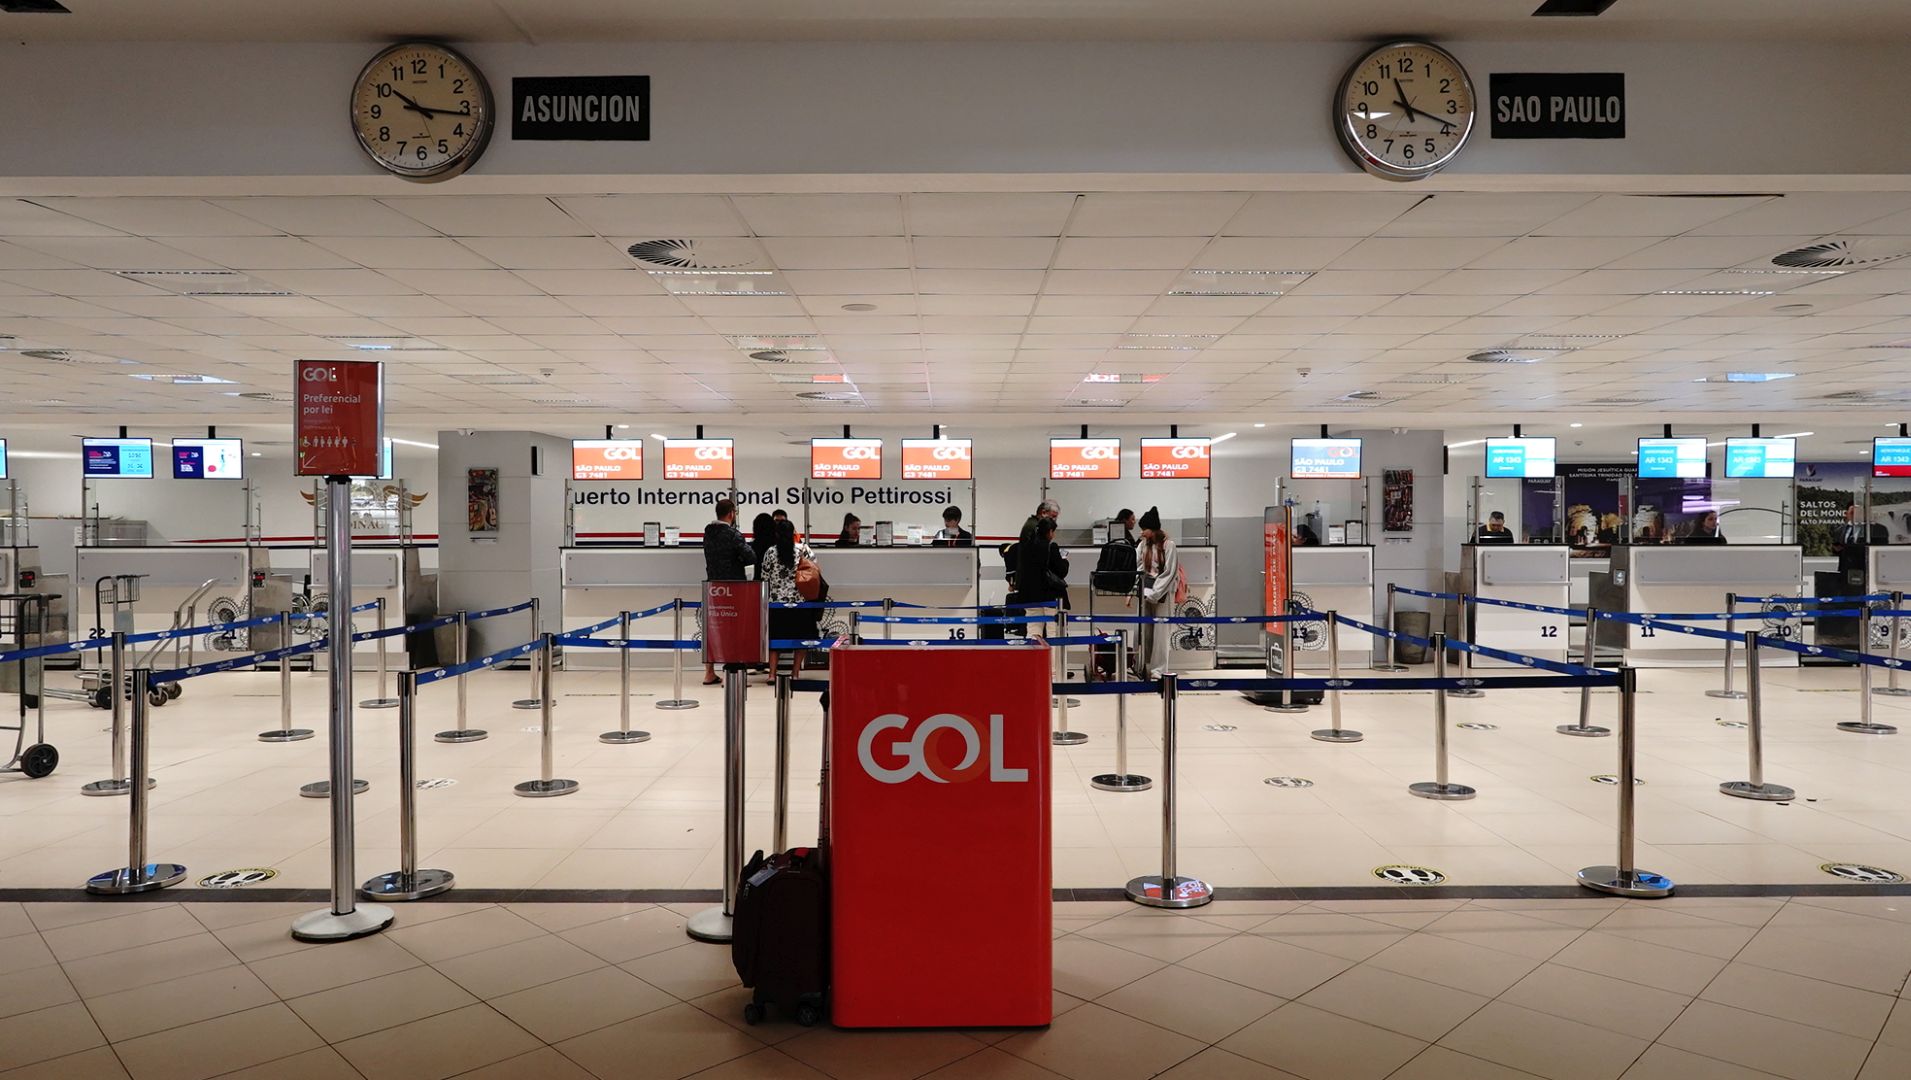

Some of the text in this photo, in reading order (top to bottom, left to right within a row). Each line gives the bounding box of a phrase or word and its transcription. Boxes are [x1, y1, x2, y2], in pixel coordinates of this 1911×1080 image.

[413, 59, 427, 74] 12
[438, 64, 444, 78] 1
[1379, 65, 1390, 79] 11
[1400, 59, 1413, 73] 12
[1425, 64, 1431, 78] 1
[392, 66, 404, 81] 11
[376, 83, 392, 98] 10
[453, 79, 464, 94] 2
[1362, 82, 1378, 96] 10
[1439, 79, 1450, 93] 2
[370, 104, 381, 119] 9
[460, 100, 470, 114] 3
[521, 96, 640, 122] ASUNCION
[1358, 103, 1368, 117] 9
[1446, 100, 1457, 114] 3
[1497, 96, 1621, 123] SAO PAULO
[379, 127, 390, 142] 8
[453, 124, 464, 137] 4
[1367, 124, 1377, 138] 8
[1440, 122, 1452, 136] 4
[397, 141, 407, 155] 7
[417, 146, 427, 160] 6
[438, 140, 448, 154] 5
[1384, 139, 1394, 153] 7
[1404, 144, 1414, 159] 6
[1424, 139, 1435, 153] 5
[303, 368, 337, 382] GOL
[304, 394, 361, 403] Preferencial
[304, 405, 333, 415] por lei
[604, 448, 641, 460] GOL
[694, 447, 732, 460] GOL
[843, 447, 880, 459] GOL
[933, 447, 970, 460] GOL
[1081, 447, 1119, 459] GOL
[1172, 446, 1209, 459] GOL
[574, 488, 630, 504] uerto
[787, 487, 844, 504] Silvio
[852, 487, 951, 504] Pettirossi
[709, 586, 732, 596] GOL
[89, 628, 106, 639] 22
[222, 630, 236, 639] 21
[948, 628, 965, 640] 16
[1190, 627, 1203, 639] 14
[1293, 628, 1307, 639] 13
[1541, 626, 1557, 637] 12
[1641, 627, 1655, 637] 11
[1776, 626, 1791, 637] 10
[1881, 626, 1889, 637] 9
[857, 713, 1029, 783] GOL
